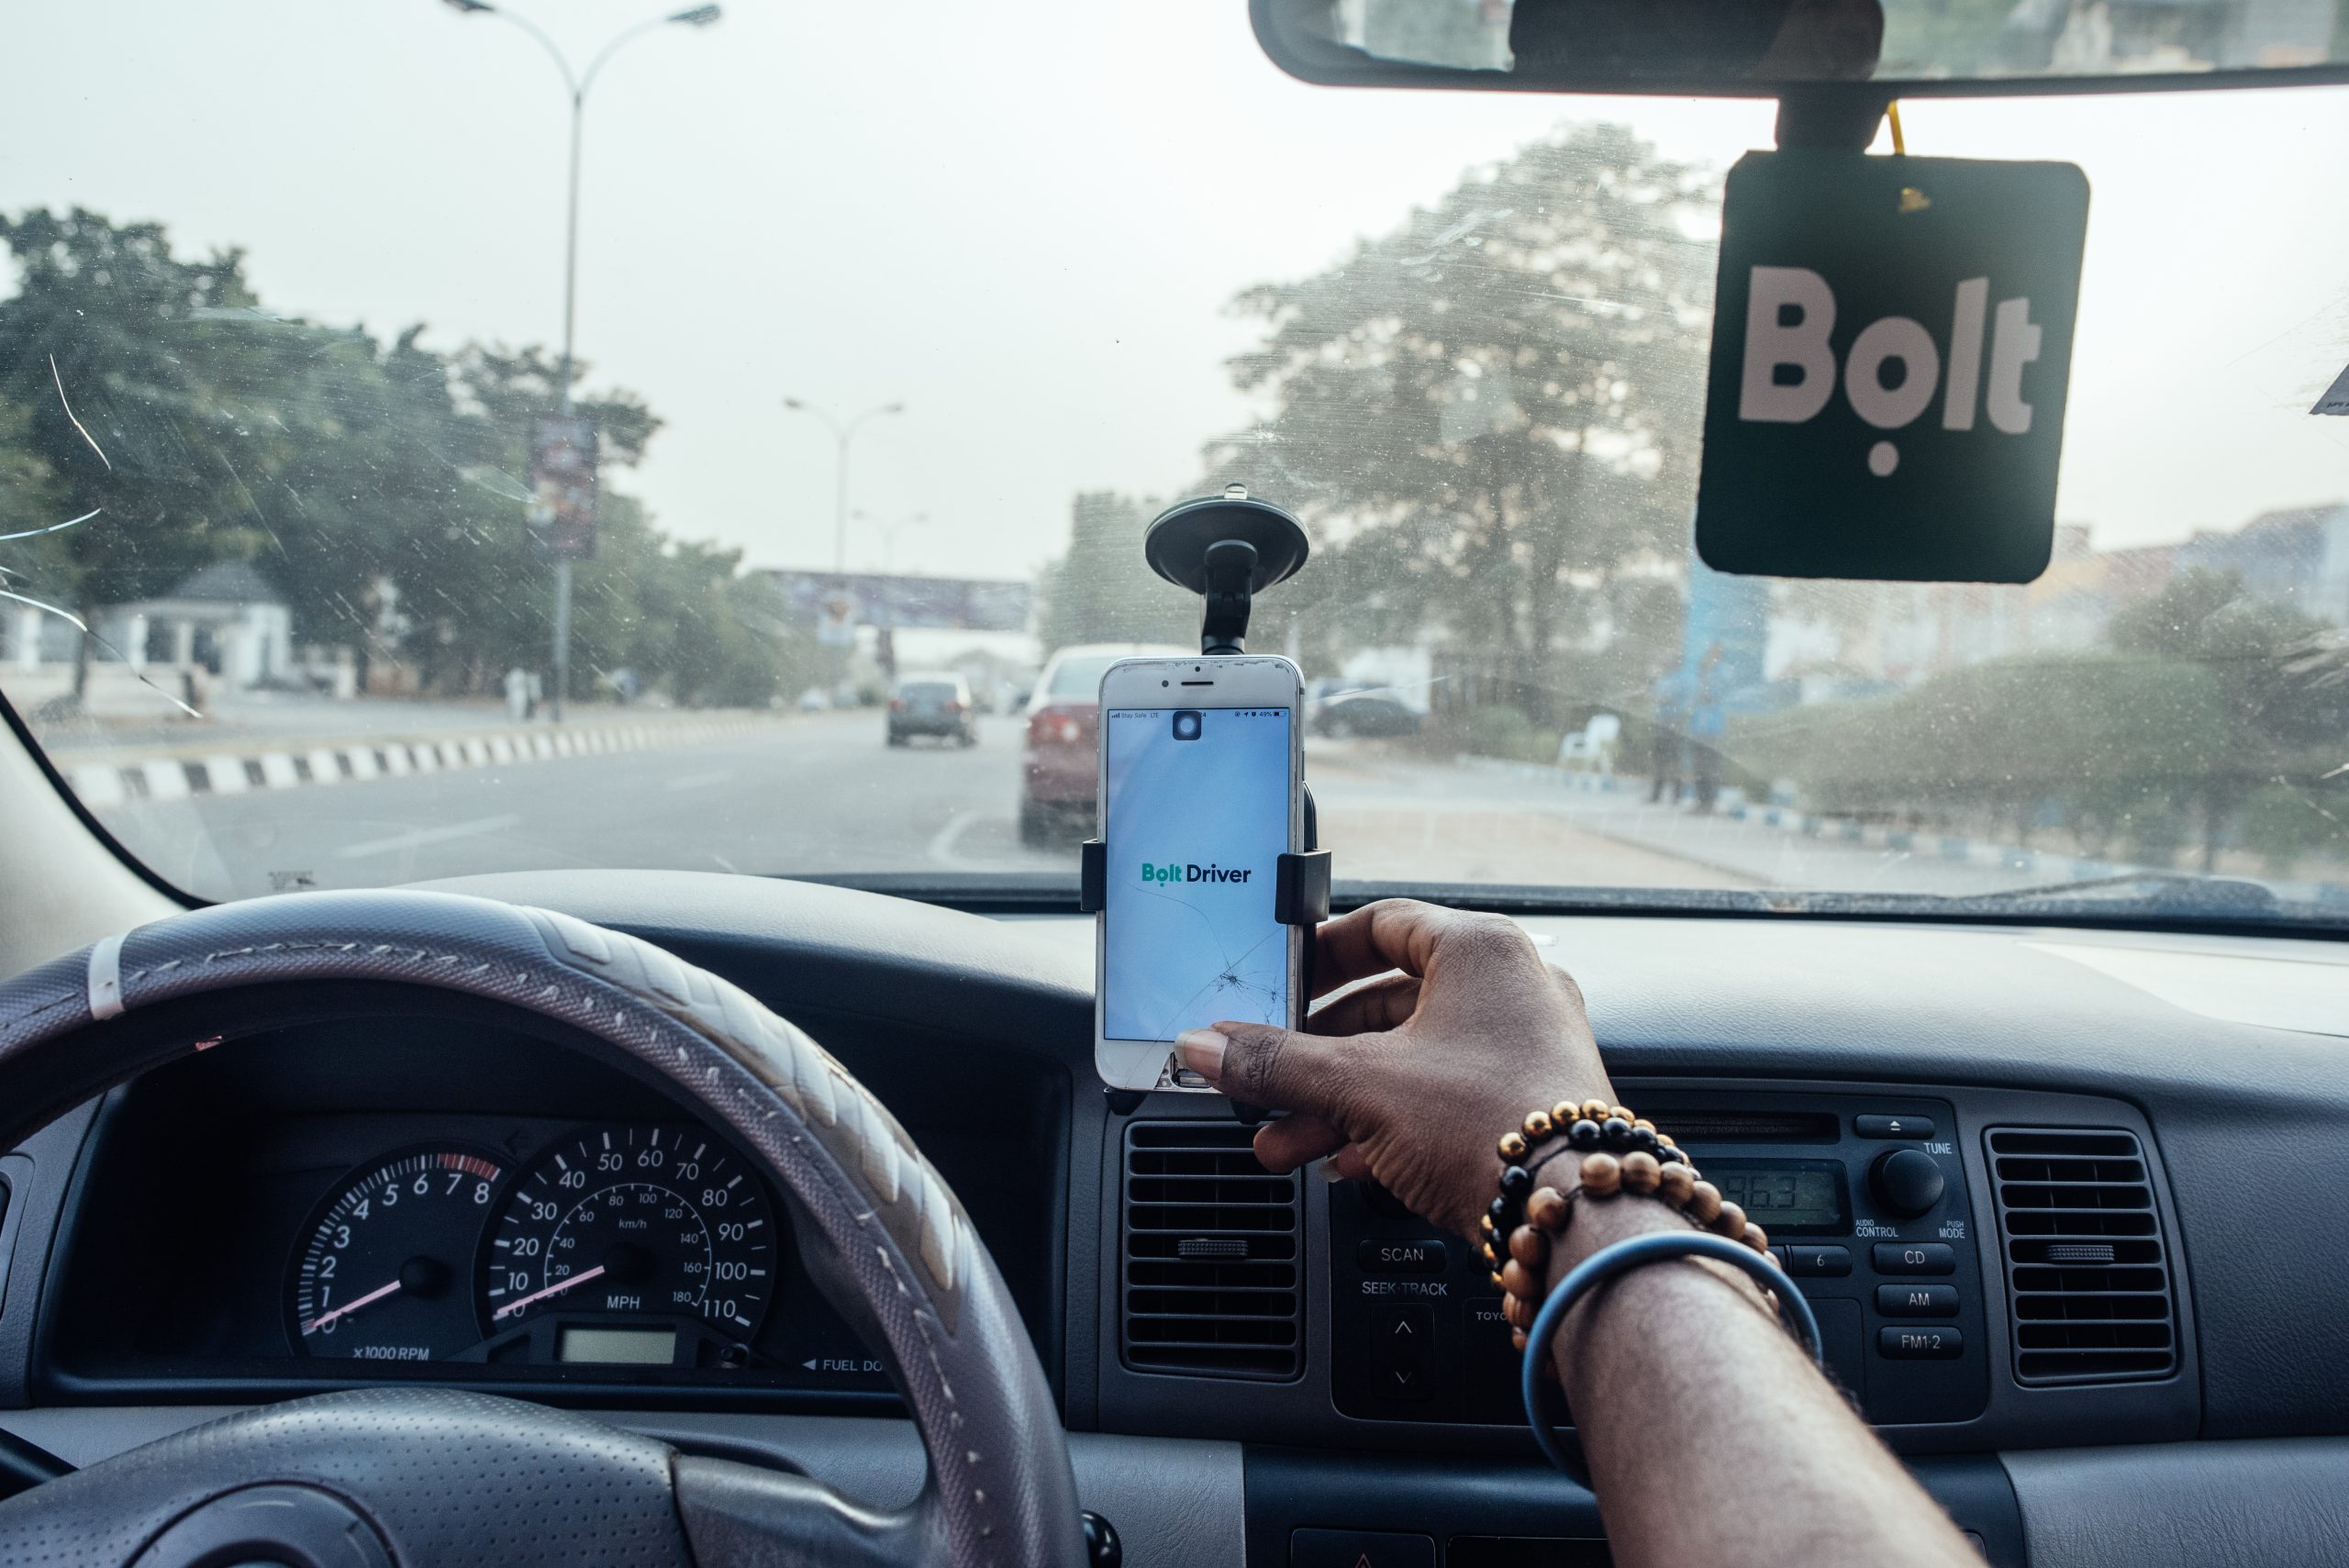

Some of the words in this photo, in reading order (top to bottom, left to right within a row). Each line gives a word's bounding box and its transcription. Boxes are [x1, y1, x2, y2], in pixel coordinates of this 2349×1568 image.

[1739, 265, 2043, 477] Bolt
[1141, 862, 1182, 887] Bolt
[1186, 863, 1252, 884] Driver
[1923, 1142, 1953, 1155] TUNE
[597, 1153, 624, 1171] 50
[637, 1150, 663, 1167] 60
[675, 1162, 699, 1180] 70
[413, 1173, 429, 1195] 6
[446, 1173, 462, 1195] 7
[559, 1171, 585, 1188] 40
[382, 1184, 399, 1206] 5
[473, 1182, 490, 1204] 8
[639, 1193, 657, 1205] 100
[701, 1189, 728, 1207] 80
[608, 1195, 624, 1206] 80
[352, 1198, 370, 1220] 4
[531, 1202, 558, 1220] 30
[664, 1208, 683, 1218] 120
[579, 1211, 595, 1222] 60
[618, 1218, 647, 1229] km/h
[1855, 1218, 1875, 1227] AUDIO
[1946, 1220, 1965, 1229] PUSH
[333, 1225, 351, 1249] 3
[680, 1233, 698, 1244] 140
[718, 1223, 744, 1241] 90
[1856, 1227, 1899, 1238] CONTROL
[1939, 1228, 1965, 1240] MODE
[513, 1238, 540, 1256] 20
[559, 1238, 574, 1249] 40
[1381, 1248, 1424, 1262] SCAN
[1817, 1254, 1825, 1267] 6
[1904, 1251, 1925, 1264] CD
[319, 1256, 337, 1278] 2
[555, 1264, 570, 1275] 20
[684, 1262, 702, 1273] 160
[715, 1262, 747, 1281] 100
[508, 1273, 529, 1291] 10
[322, 1285, 330, 1307] 1
[607, 1296, 640, 1309] MPH
[673, 1292, 692, 1303] 180
[1909, 1293, 1930, 1307] AM
[703, 1299, 736, 1318] 110
[1475, 1312, 1508, 1321] TOYO
[398, 1348, 429, 1361] RPM
[823, 1360, 858, 1372] FUEL
[863, 1361, 883, 1372] DO
